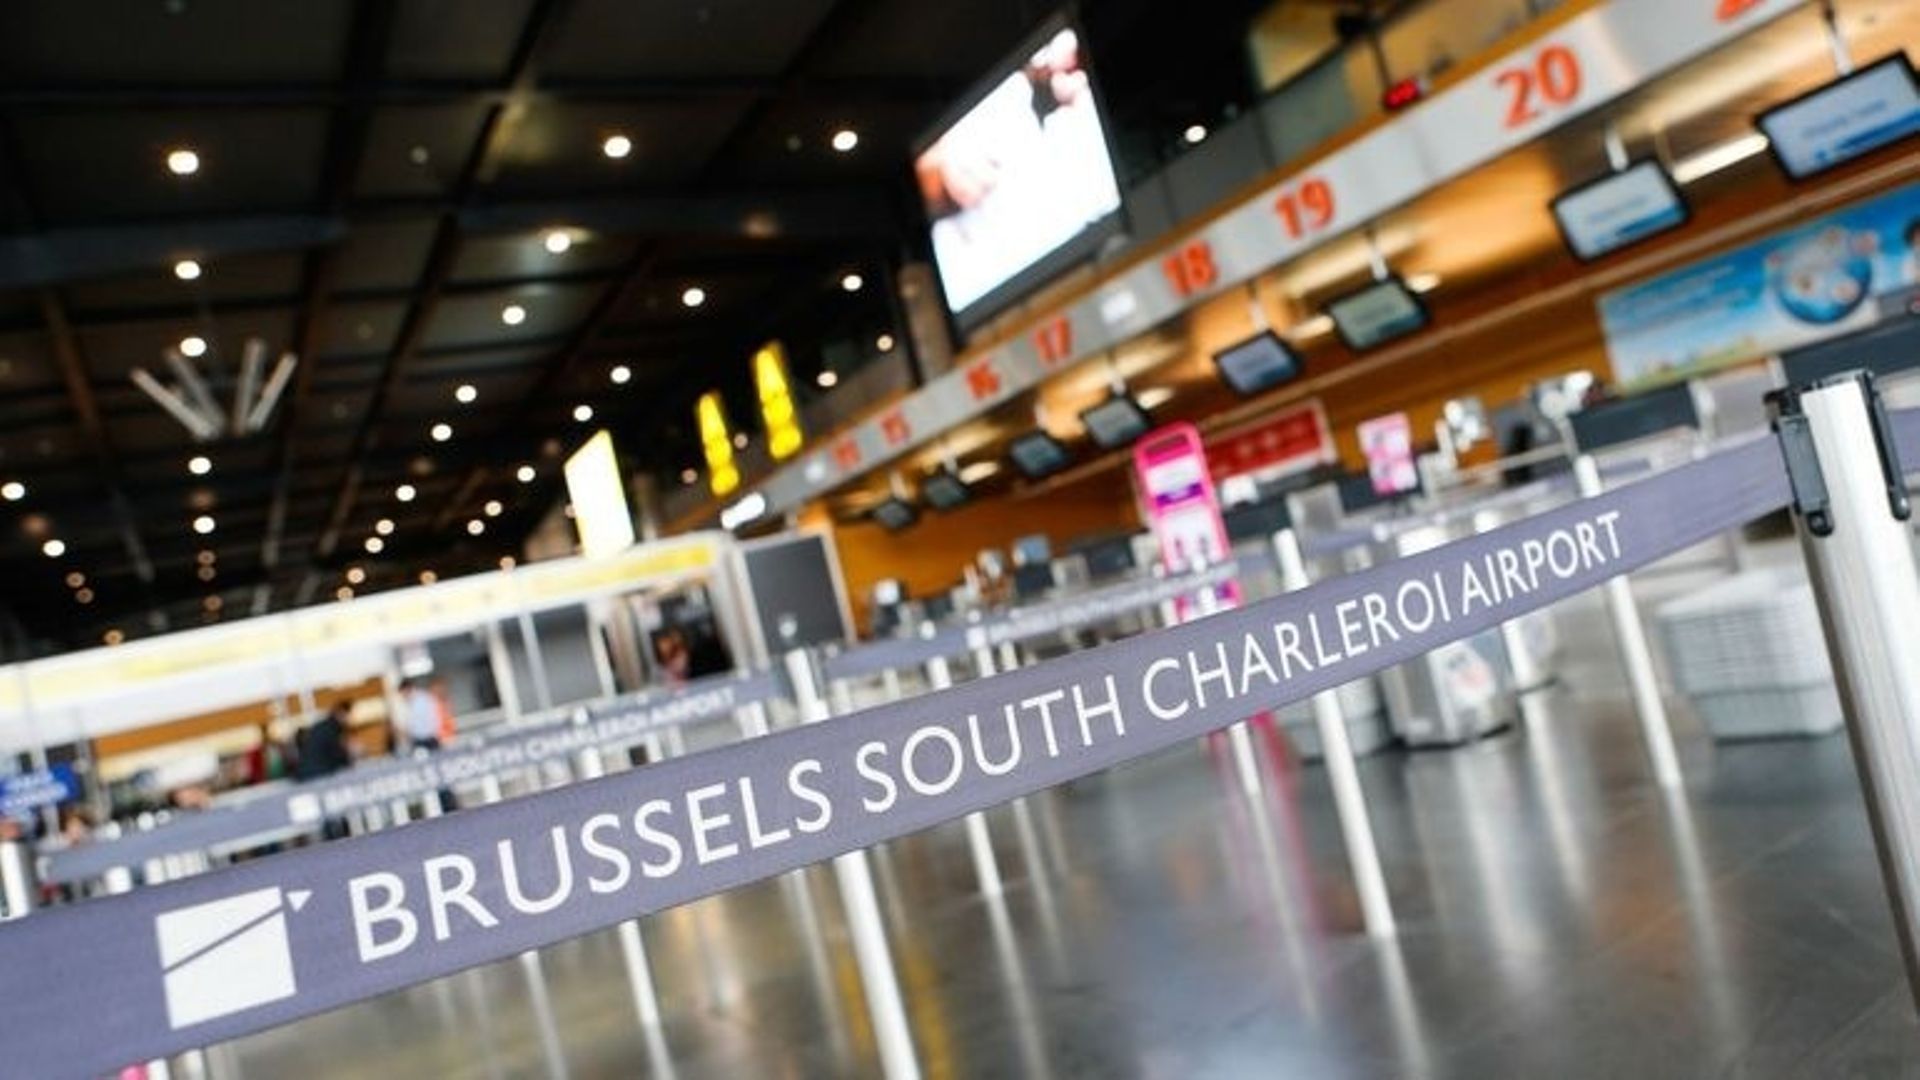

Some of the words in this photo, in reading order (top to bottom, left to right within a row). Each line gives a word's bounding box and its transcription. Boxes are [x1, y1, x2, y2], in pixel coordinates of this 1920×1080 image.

[1496, 44, 1581, 127] 20
[1275, 179, 1335, 238] 19
[1163, 241, 1217, 295] 18
[1032, 317, 1072, 362] 17
[348, 758, 833, 964] BRUSSELS
[855, 673, 1126, 813] SOUTH
[1142, 571, 1451, 721] CHARLEROI
[1461, 510, 1622, 616] AIRPORT
